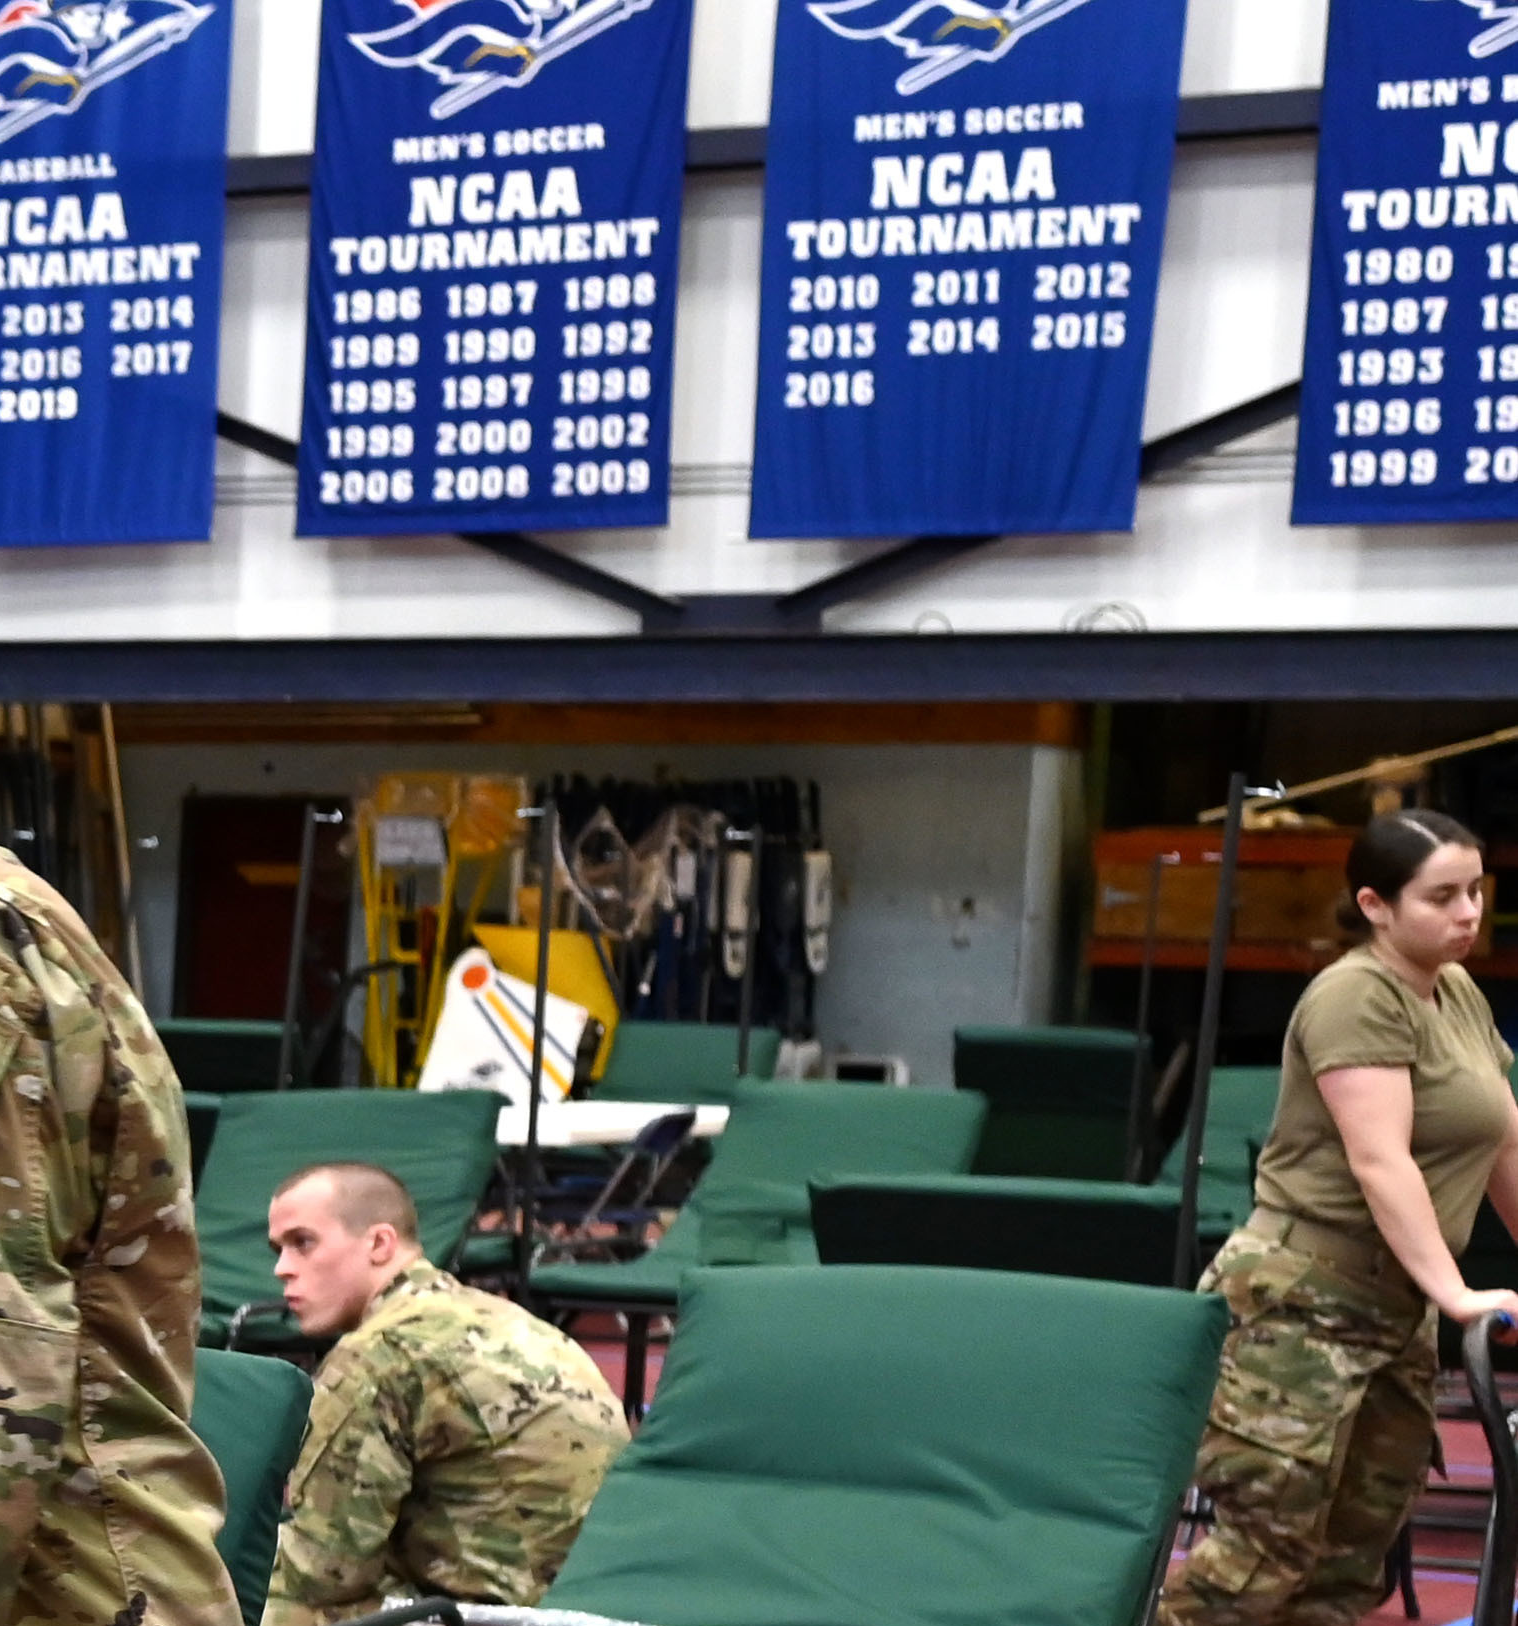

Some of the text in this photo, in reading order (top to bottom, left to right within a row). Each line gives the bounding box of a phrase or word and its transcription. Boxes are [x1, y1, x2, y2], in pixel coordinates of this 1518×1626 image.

[1377, 76, 1490, 110] MEN'S
[392, 123, 606, 164] MEN'S SOCCER
[854, 101, 1084, 143] MEN'S SOCCER
[408, 167, 582, 227] NCAA
[870, 147, 1056, 210] NCAA
[329, 217, 660, 276] TOURNAMENT
[786, 203, 1142, 261] TOURNAMENT
[788, 261, 1132, 312] 2010 2011 2012
[1344, 246, 1454, 286] 1980
[1, 301, 84, 336] 2013
[109, 296, 194, 332] 2014
[333, 272, 656, 324] 1986 1987 1988
[1341, 296, 1449, 336] 1987
[330, 319, 653, 368] 1989 1990 1992
[786, 311, 1127, 360] 2013 2014 2015
[0, 346, 82, 381] 2016
[111, 340, 193, 376] 2017
[1338, 347, 1445, 386] 1993
[330, 366, 651, 413] 1995 1997 1998
[784, 370, 875, 408] 2016
[326, 412, 650, 459] 1999 2000 2002
[1334, 397, 1442, 437] 1996
[320, 459, 650, 504] 2006 2008 2009
[1330, 449, 1438, 487] 1999
